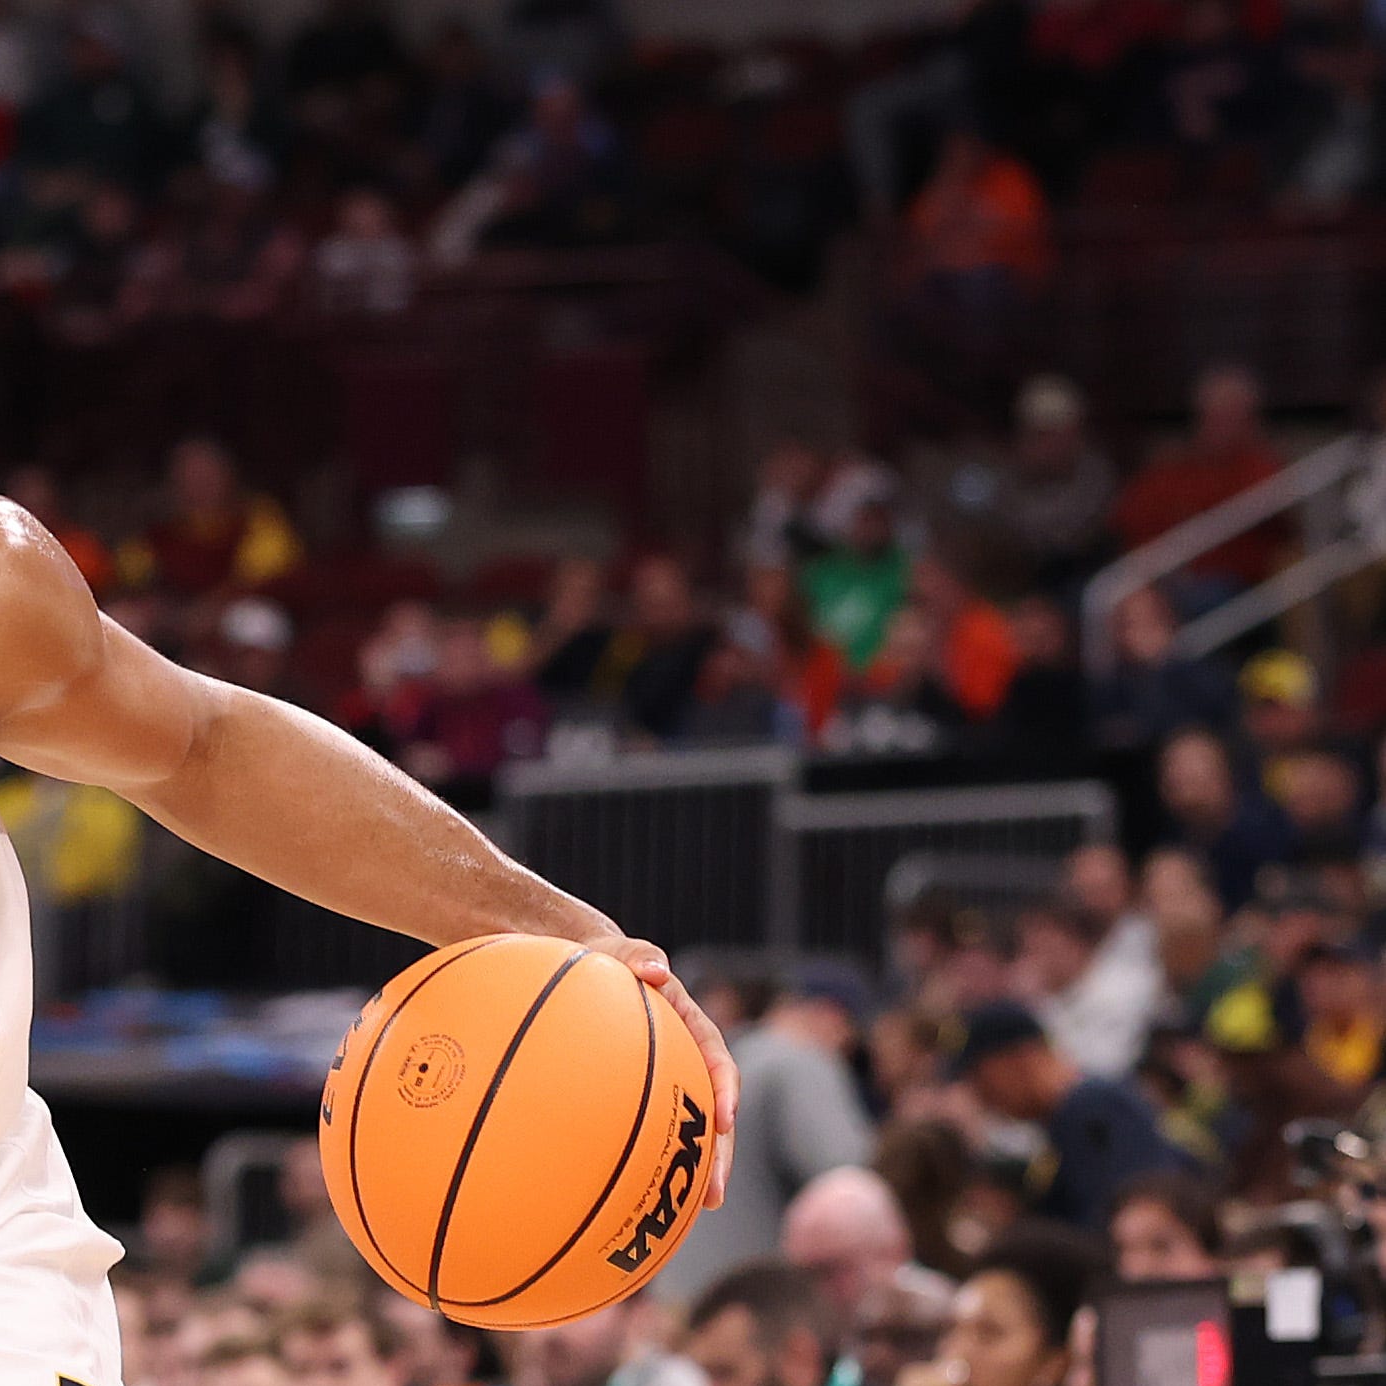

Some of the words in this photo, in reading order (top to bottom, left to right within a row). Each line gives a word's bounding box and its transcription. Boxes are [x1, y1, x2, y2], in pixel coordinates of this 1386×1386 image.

[660, 1084, 679, 1161] OFFICIAL
[606, 1091, 707, 1273] NCAA
[633, 1166, 663, 1215] GAME
[598, 1216, 634, 1253] BALL
